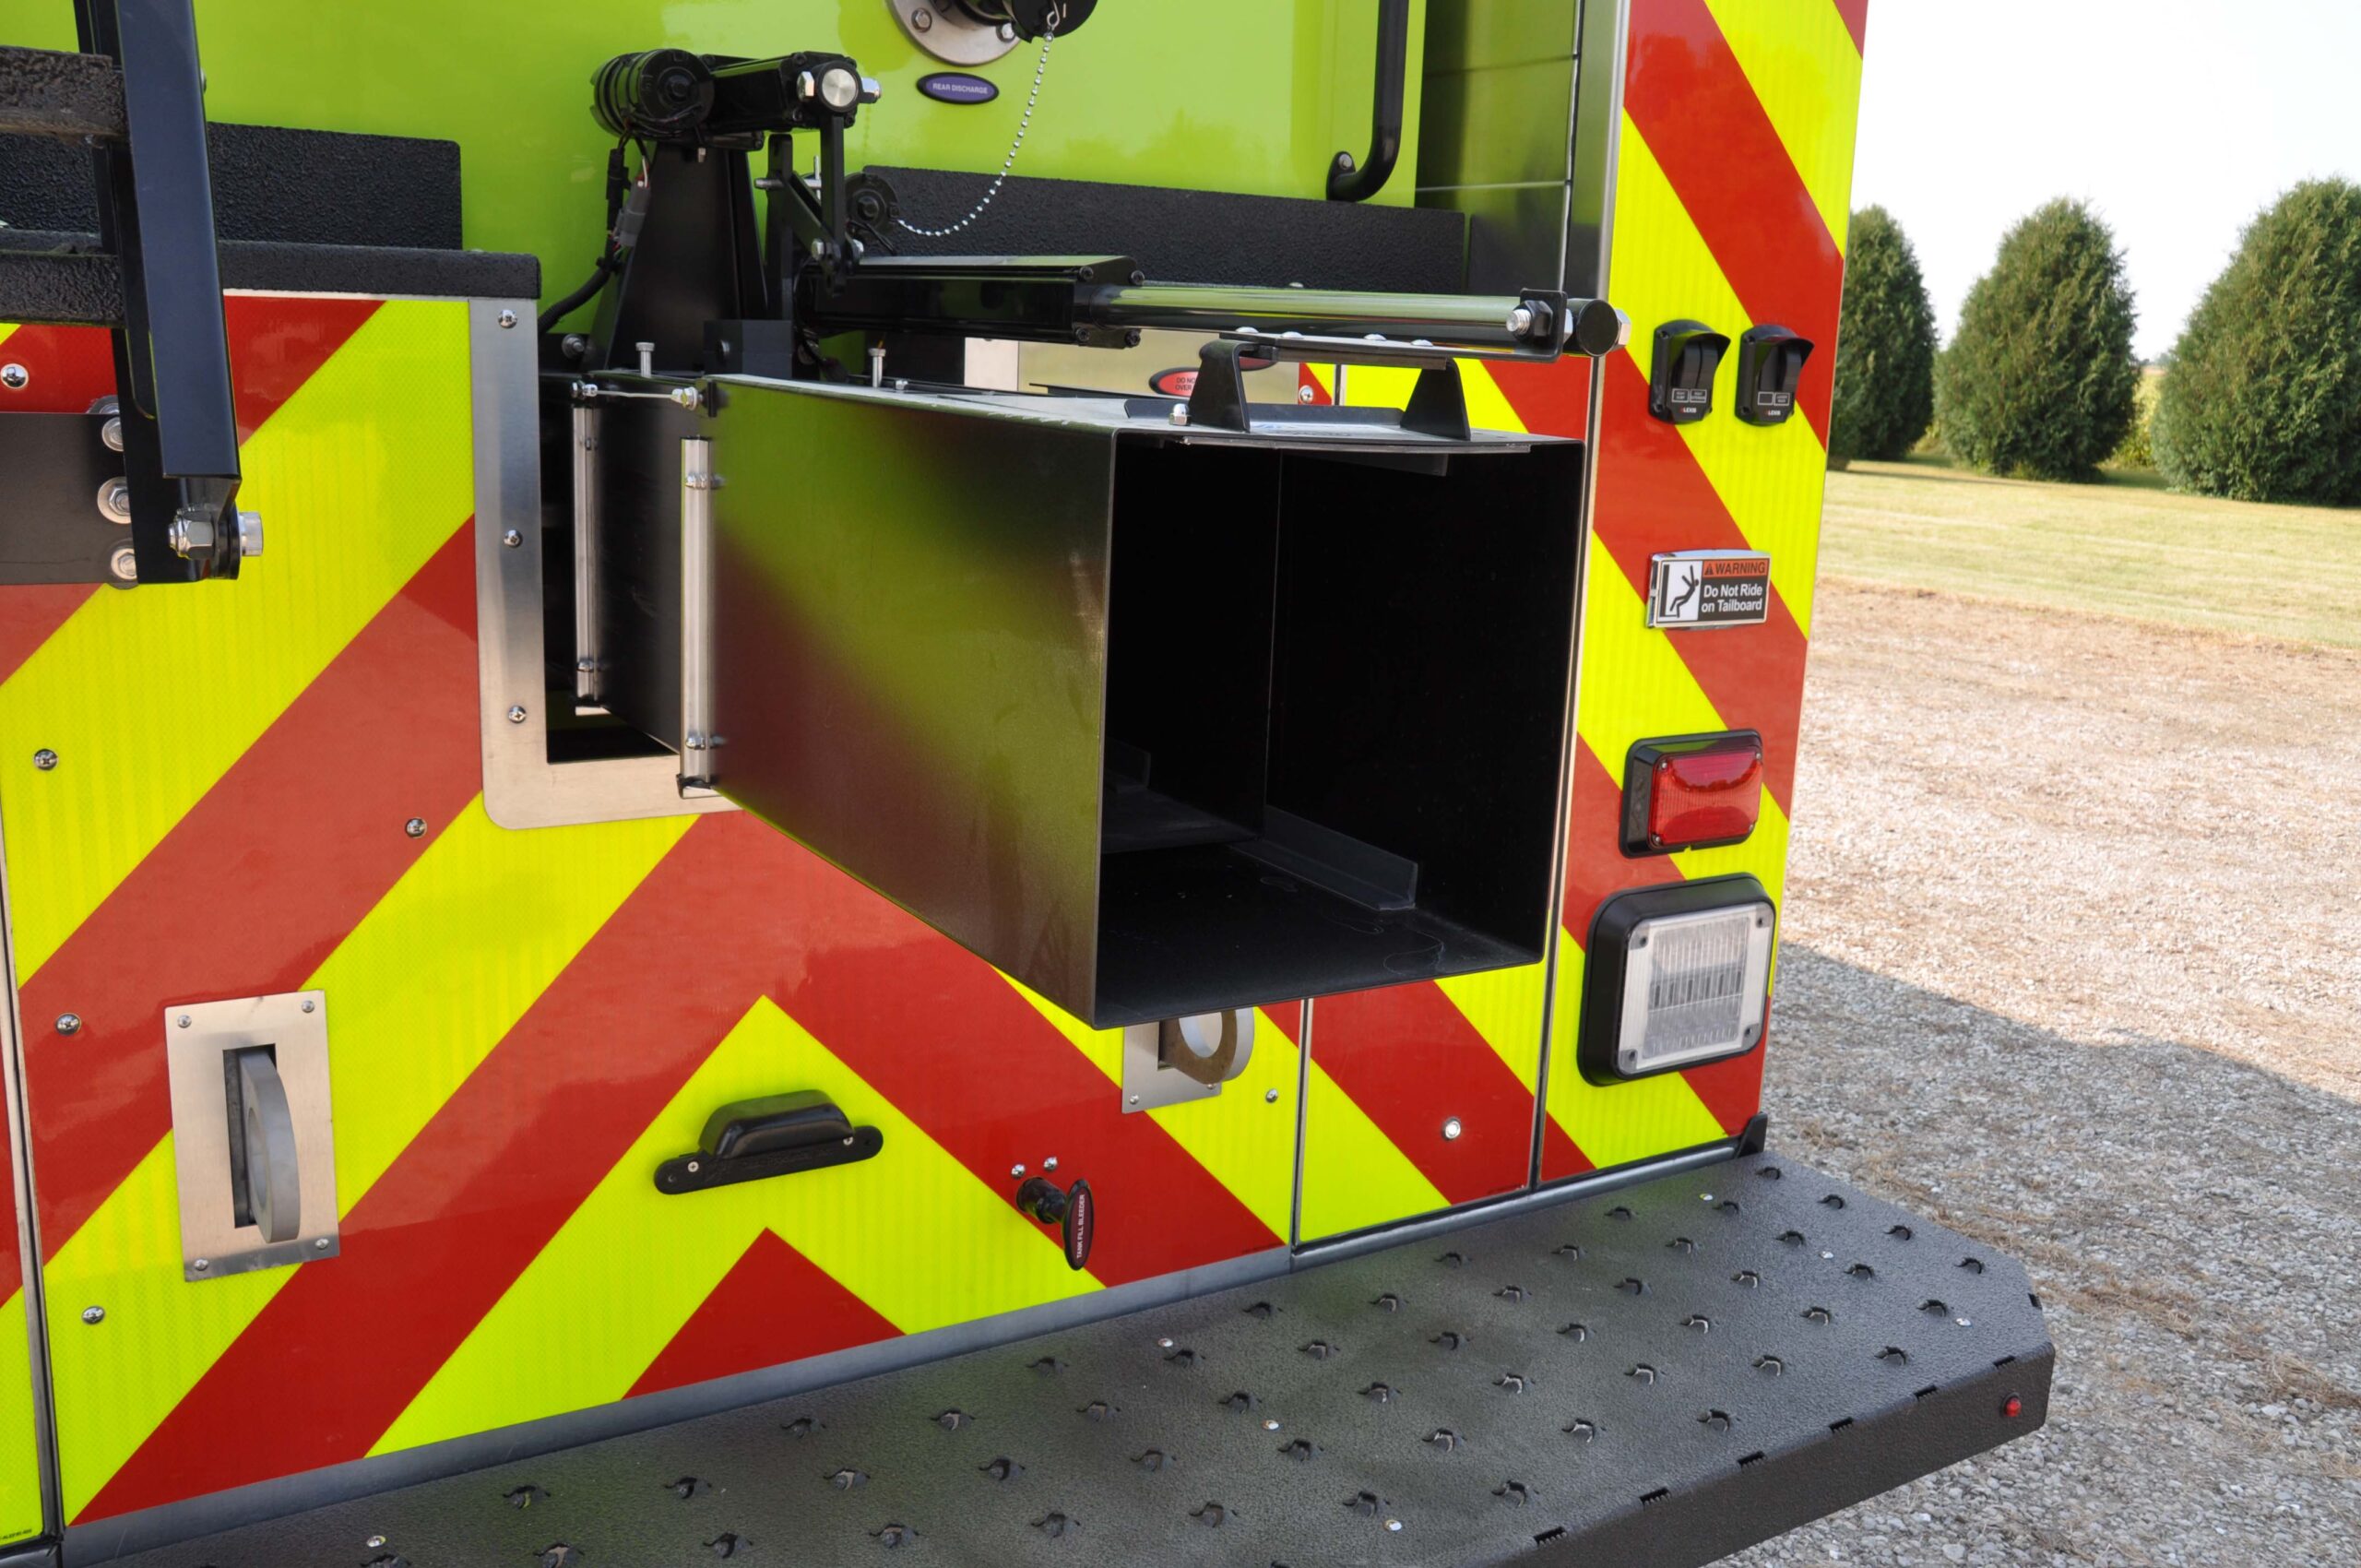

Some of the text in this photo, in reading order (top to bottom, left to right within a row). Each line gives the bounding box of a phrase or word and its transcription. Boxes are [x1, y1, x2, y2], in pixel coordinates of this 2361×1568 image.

[952, 84, 988, 94] DISCHARGE
[1715, 562, 1765, 575] WARNING
[1703, 583, 1762, 598] Do Not Ride
[1701, 599, 1762, 612] on Tailboard
